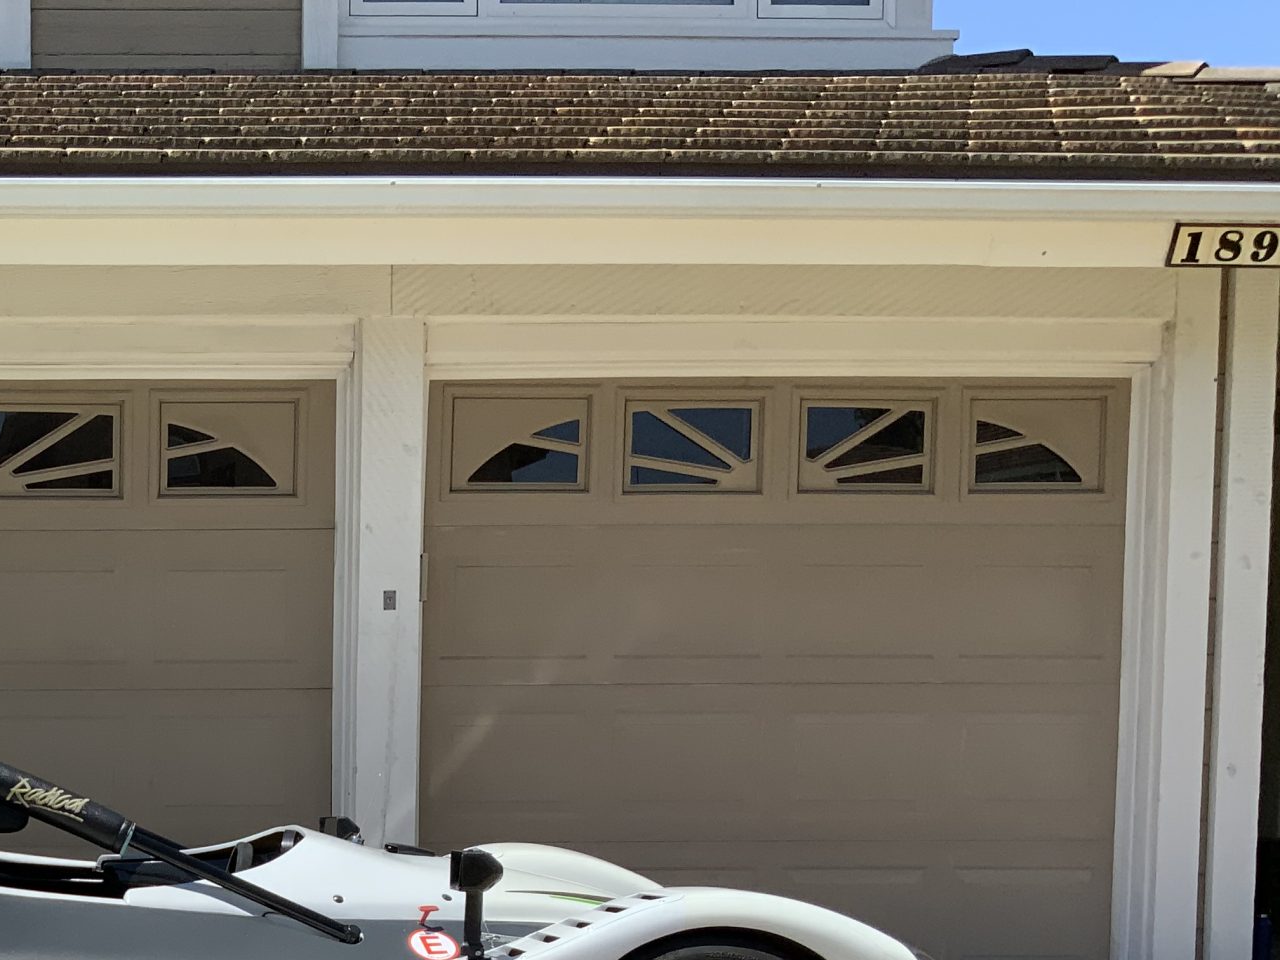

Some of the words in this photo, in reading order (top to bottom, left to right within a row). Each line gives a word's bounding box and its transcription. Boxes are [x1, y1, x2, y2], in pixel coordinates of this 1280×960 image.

[1180, 230, 1279, 263] 189
[6, 775, 90, 816] Radical
[419, 935, 448, 955] E
